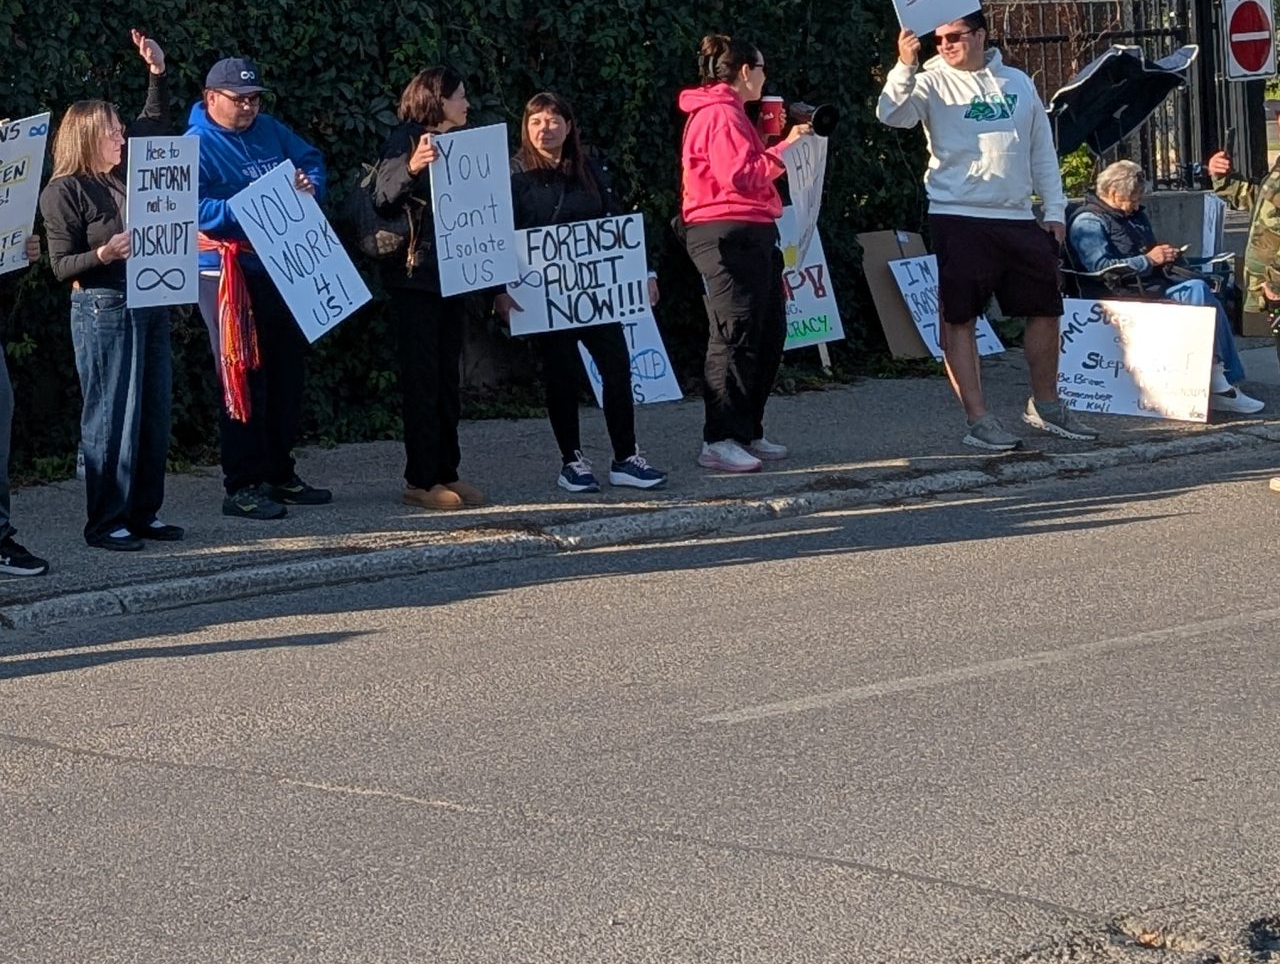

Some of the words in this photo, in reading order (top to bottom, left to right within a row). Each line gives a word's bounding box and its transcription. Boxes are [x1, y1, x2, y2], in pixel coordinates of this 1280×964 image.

[145, 140, 166, 161] Here
[169, 142, 180, 160] to
[137, 164, 191, 192] INFORM
[146, 196, 163, 213] not
[166, 196, 177, 212] to
[242, 174, 306, 244] YOU
[438, 193, 498, 232] Can't
[132, 220, 195, 258] DISRUPT
[269, 219, 341, 284] WORK
[439, 233, 505, 261] Isolate
[526, 217, 641, 265] FORENSIC
[313, 273, 331, 295] 4
[543, 255, 624, 298] AUDIT
[900, 260, 936, 287] I'M
[545, 280, 646, 329] NOW!!!
